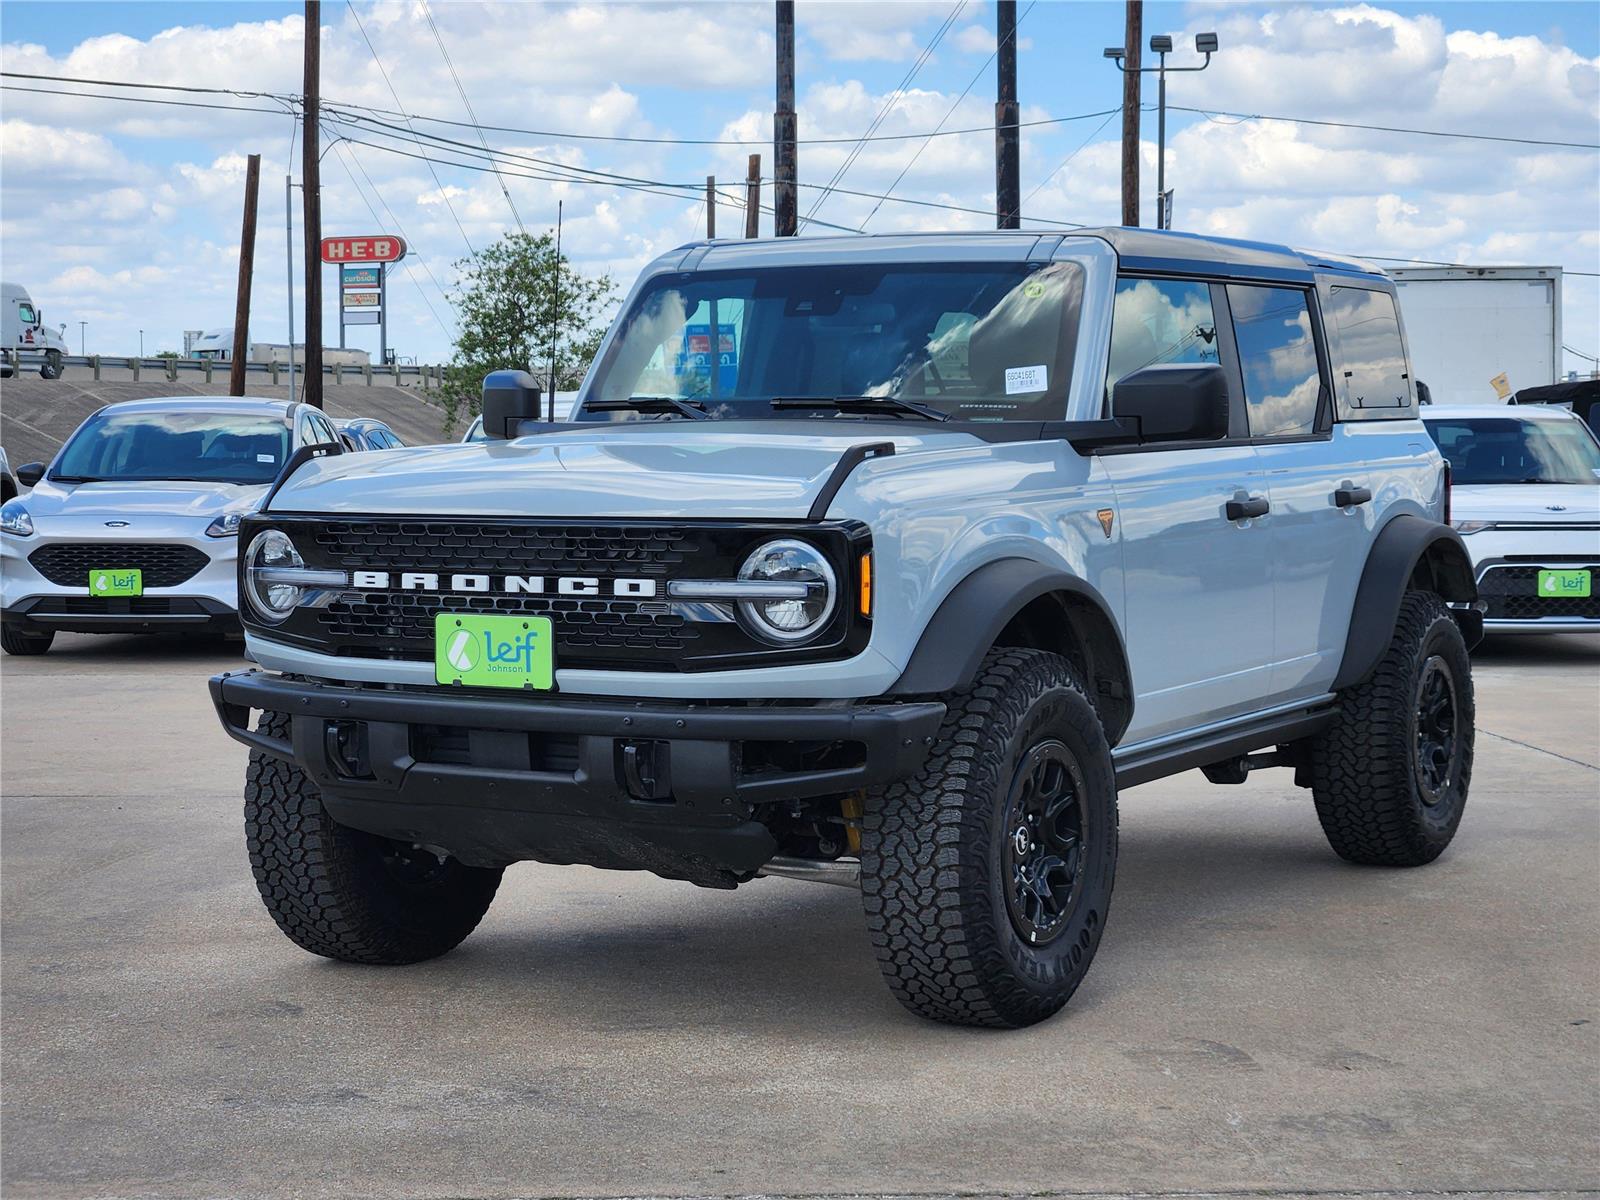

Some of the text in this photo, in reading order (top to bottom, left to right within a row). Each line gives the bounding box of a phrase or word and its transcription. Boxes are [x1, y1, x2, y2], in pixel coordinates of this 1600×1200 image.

[344, 274, 376, 282] curbside
[112, 575, 136, 590] leif
[353, 571, 656, 597] BRONCO
[1562, 576, 1585, 591] leif
[483, 631, 538, 672] leif
[486, 663, 524, 673] Johnson
